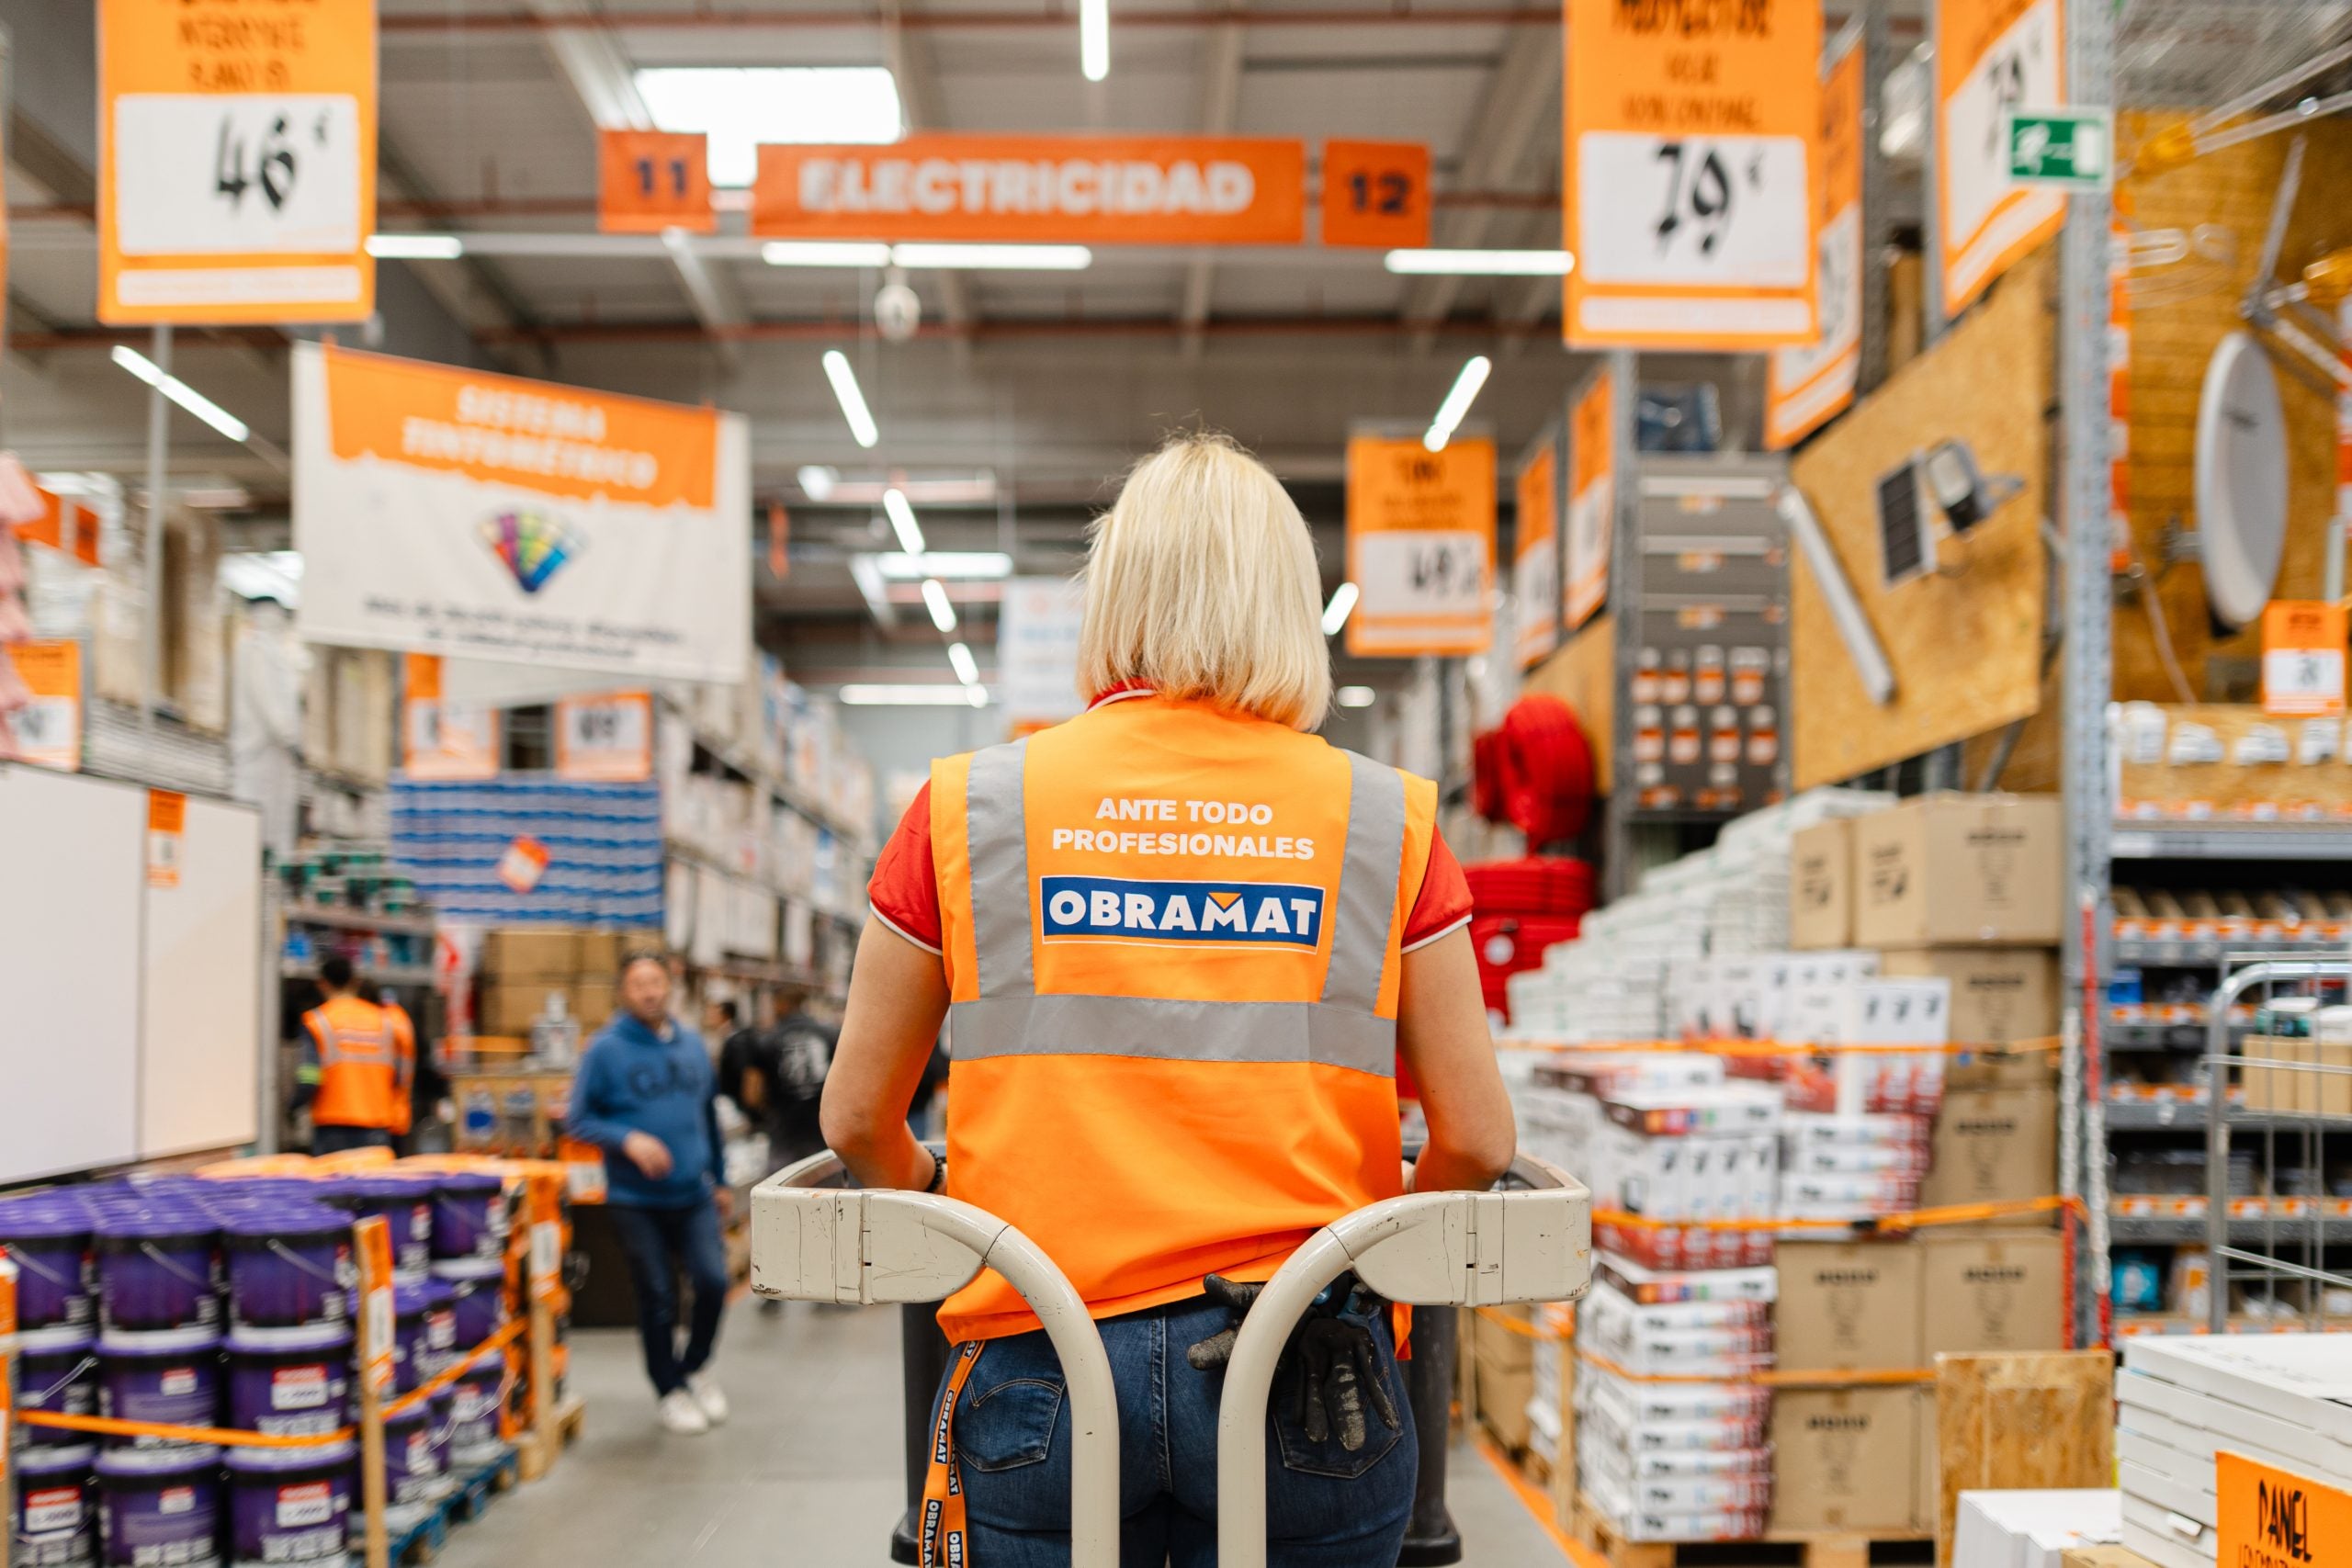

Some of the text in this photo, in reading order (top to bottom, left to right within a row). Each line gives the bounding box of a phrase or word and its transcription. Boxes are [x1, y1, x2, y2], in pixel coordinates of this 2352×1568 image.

[634, 156, 687, 199] 11
[797, 158, 1255, 215] ELECTRICIDAD
[1348, 169, 1412, 215] 12
[1095, 797, 1273, 825] ANTE TODO
[1052, 829, 1315, 860] PROFESIONALES
[1049, 889, 1317, 935] OBRAMAT
[937, 1391, 954, 1462] OBRAMAT
[2258, 1479, 2312, 1563] PANEL
